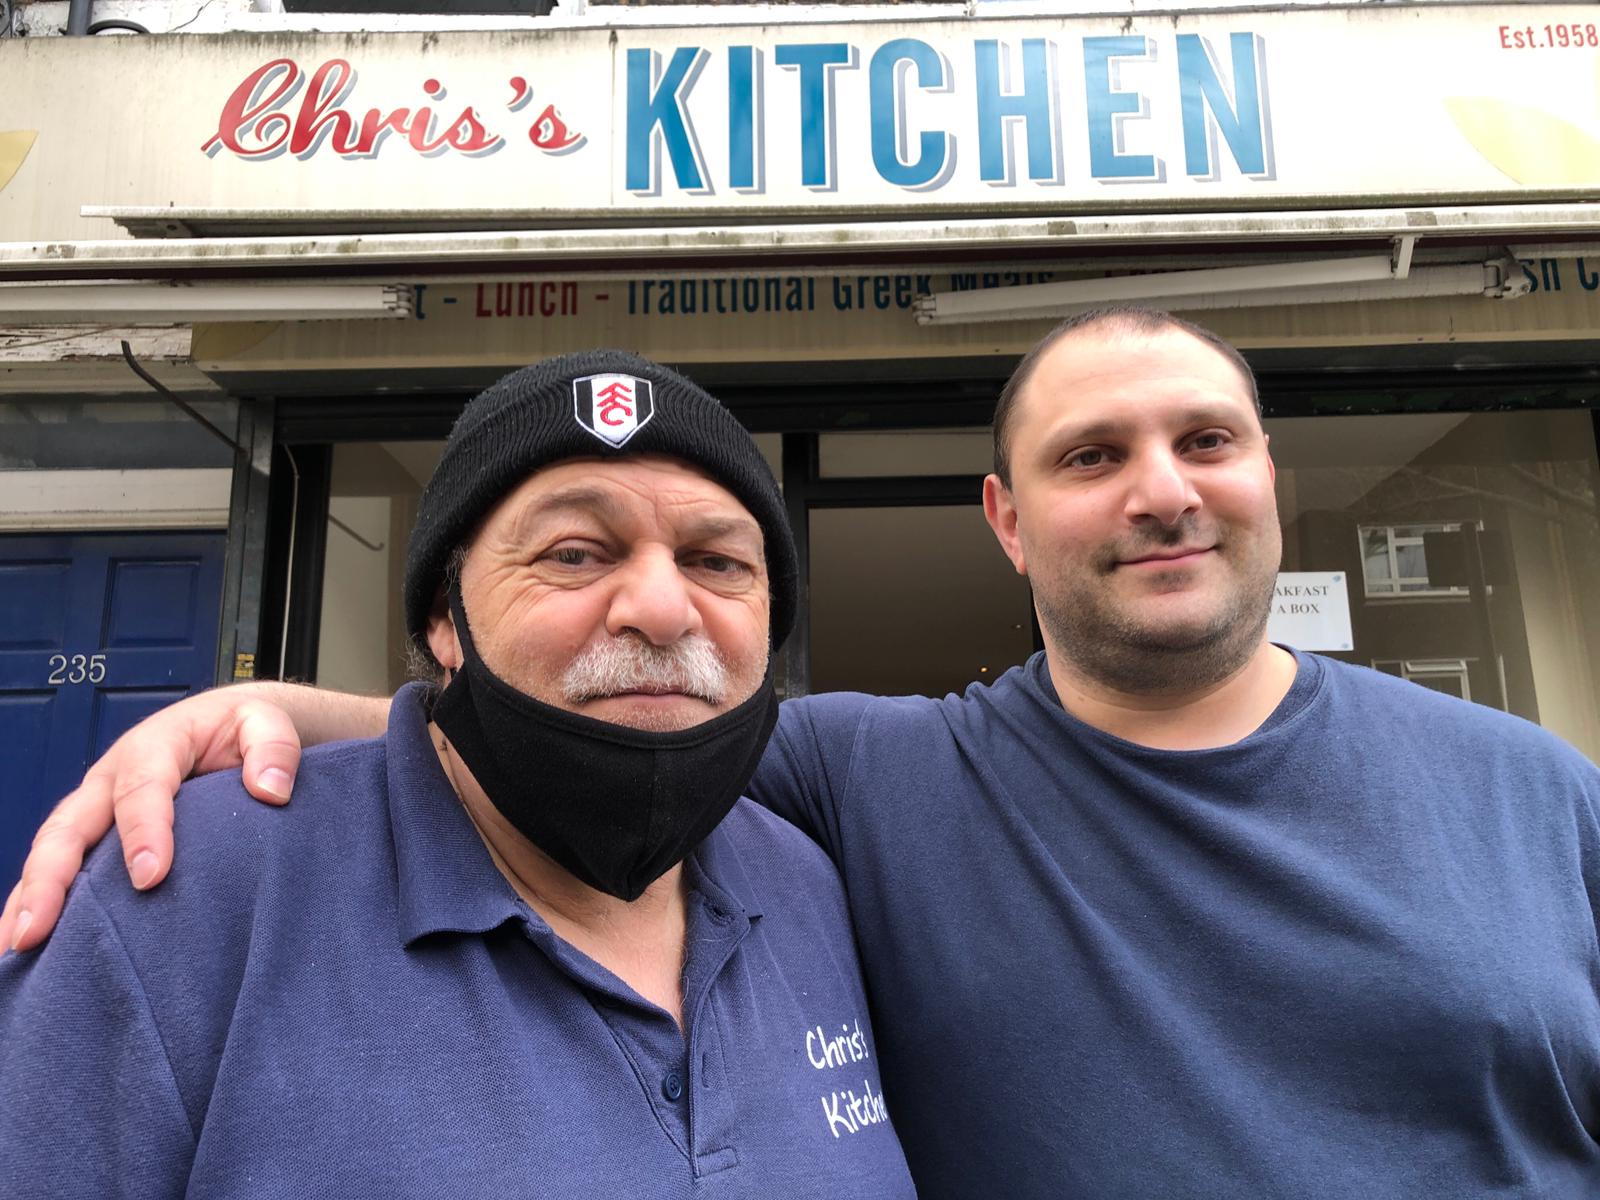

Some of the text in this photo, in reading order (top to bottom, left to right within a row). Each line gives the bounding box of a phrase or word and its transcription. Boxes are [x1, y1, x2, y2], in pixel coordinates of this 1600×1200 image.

[1499, 23, 1599, 49] Est.1958
[200, 32, 1277, 196] Chris's KITCHEN
[628, 275, 815, 315] Traditional
[1275, 585, 1329, 597] AKFAST
[1290, 603, 1320, 614] BOX
[48, 654, 106, 684] 235
[821, 1079, 887, 1138] Kitch
